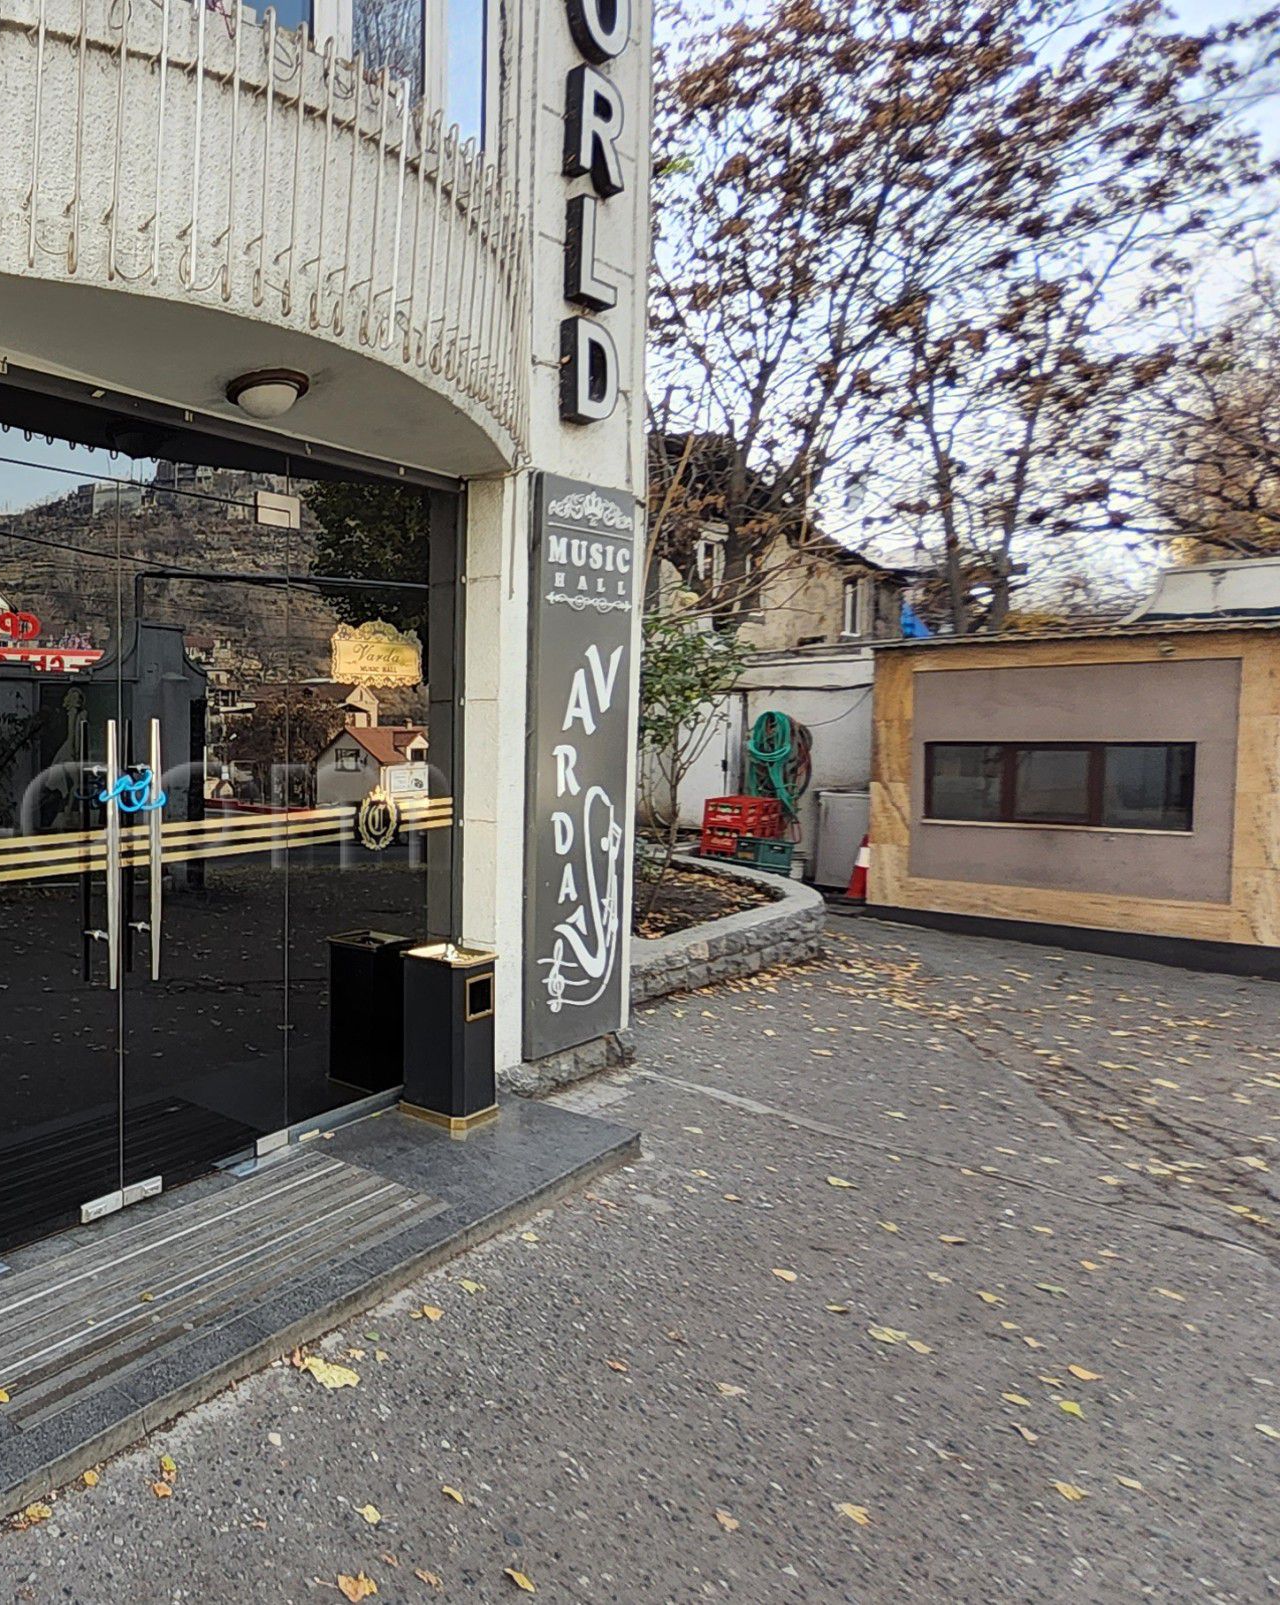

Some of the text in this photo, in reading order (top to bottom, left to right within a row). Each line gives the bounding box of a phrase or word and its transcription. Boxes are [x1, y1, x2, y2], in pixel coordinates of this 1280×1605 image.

[547, 534, 631, 574] MUSIC
[554, 572, 627, 596] HALL
[352, 643, 401, 664] Varda
[550, 643, 625, 905] VARDA
